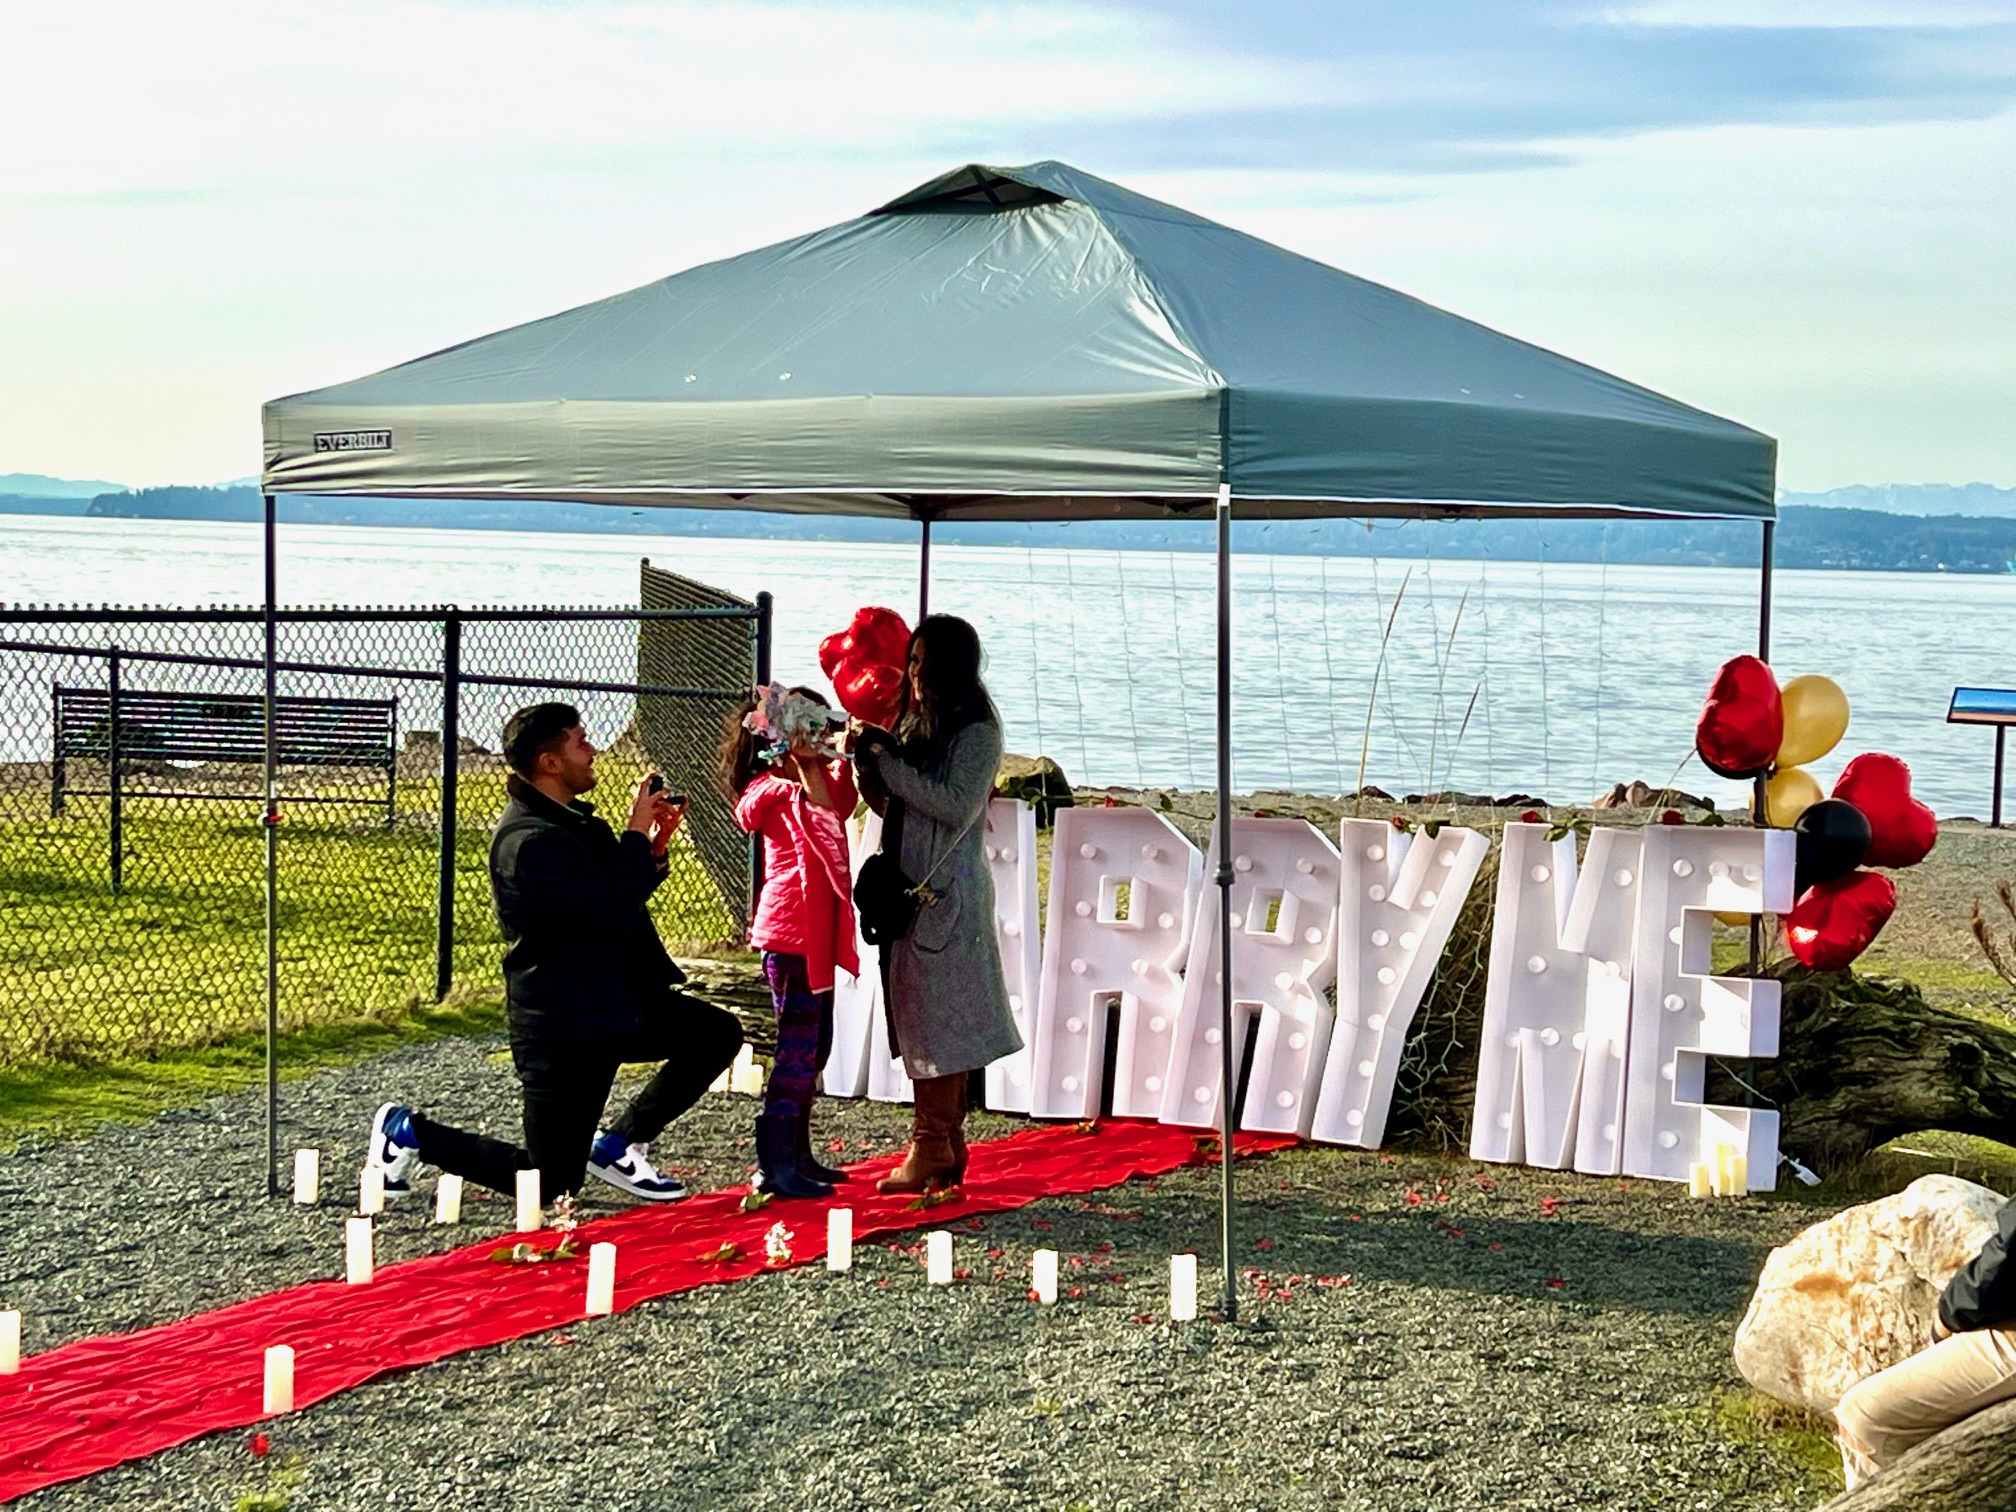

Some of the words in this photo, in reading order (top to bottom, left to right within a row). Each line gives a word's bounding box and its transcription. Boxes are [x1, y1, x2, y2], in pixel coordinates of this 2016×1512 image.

[315, 431, 390, 451] EVERBILT
[818, 798, 1491, 1150] RRY
[1470, 822, 1797, 1192] ME
